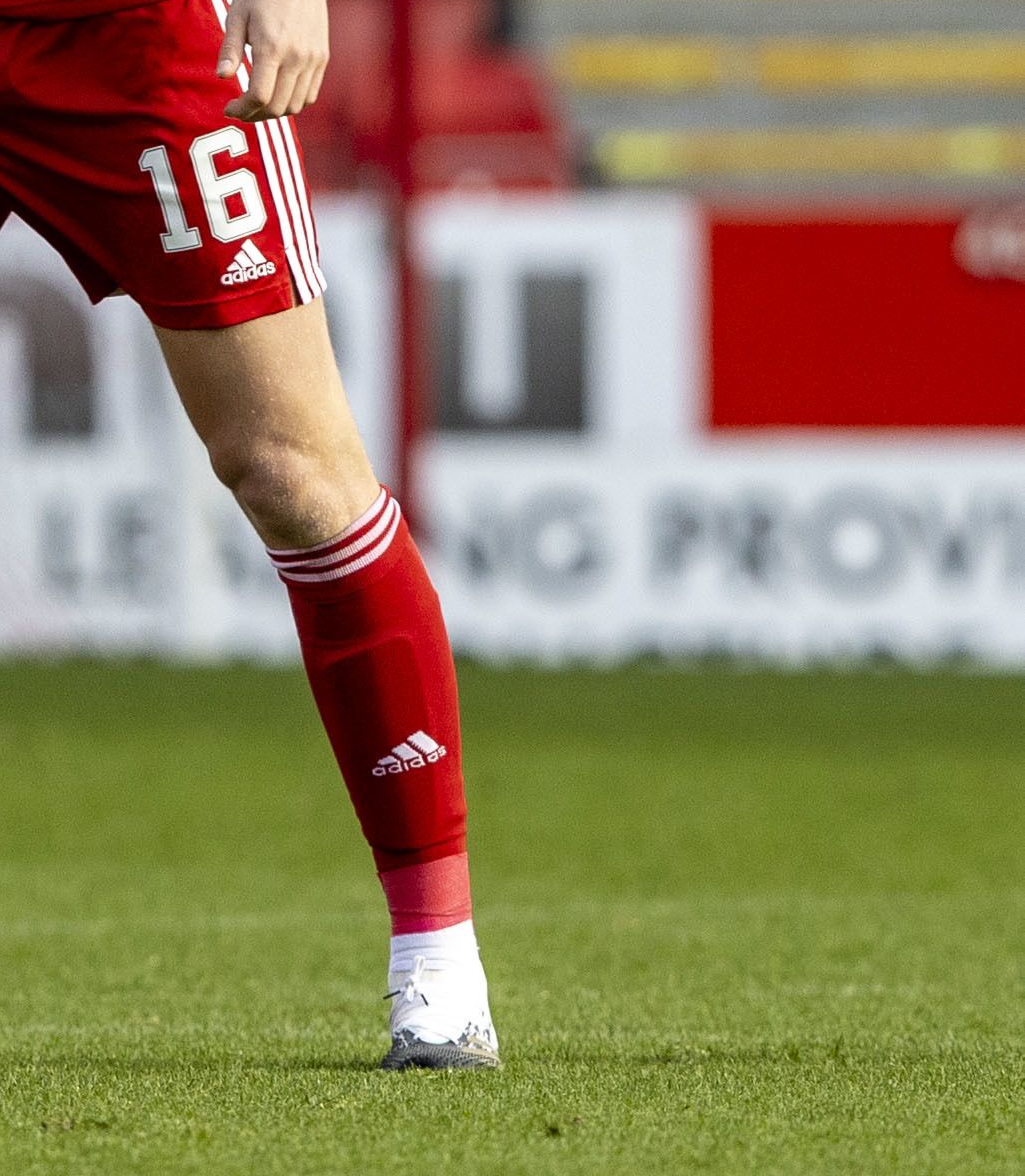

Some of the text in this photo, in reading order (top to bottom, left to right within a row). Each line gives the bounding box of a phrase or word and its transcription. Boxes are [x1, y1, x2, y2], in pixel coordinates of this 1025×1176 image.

[138, 125, 268, 253] 16
[220, 261, 276, 285] adidas
[372, 745, 448, 777] adidas
